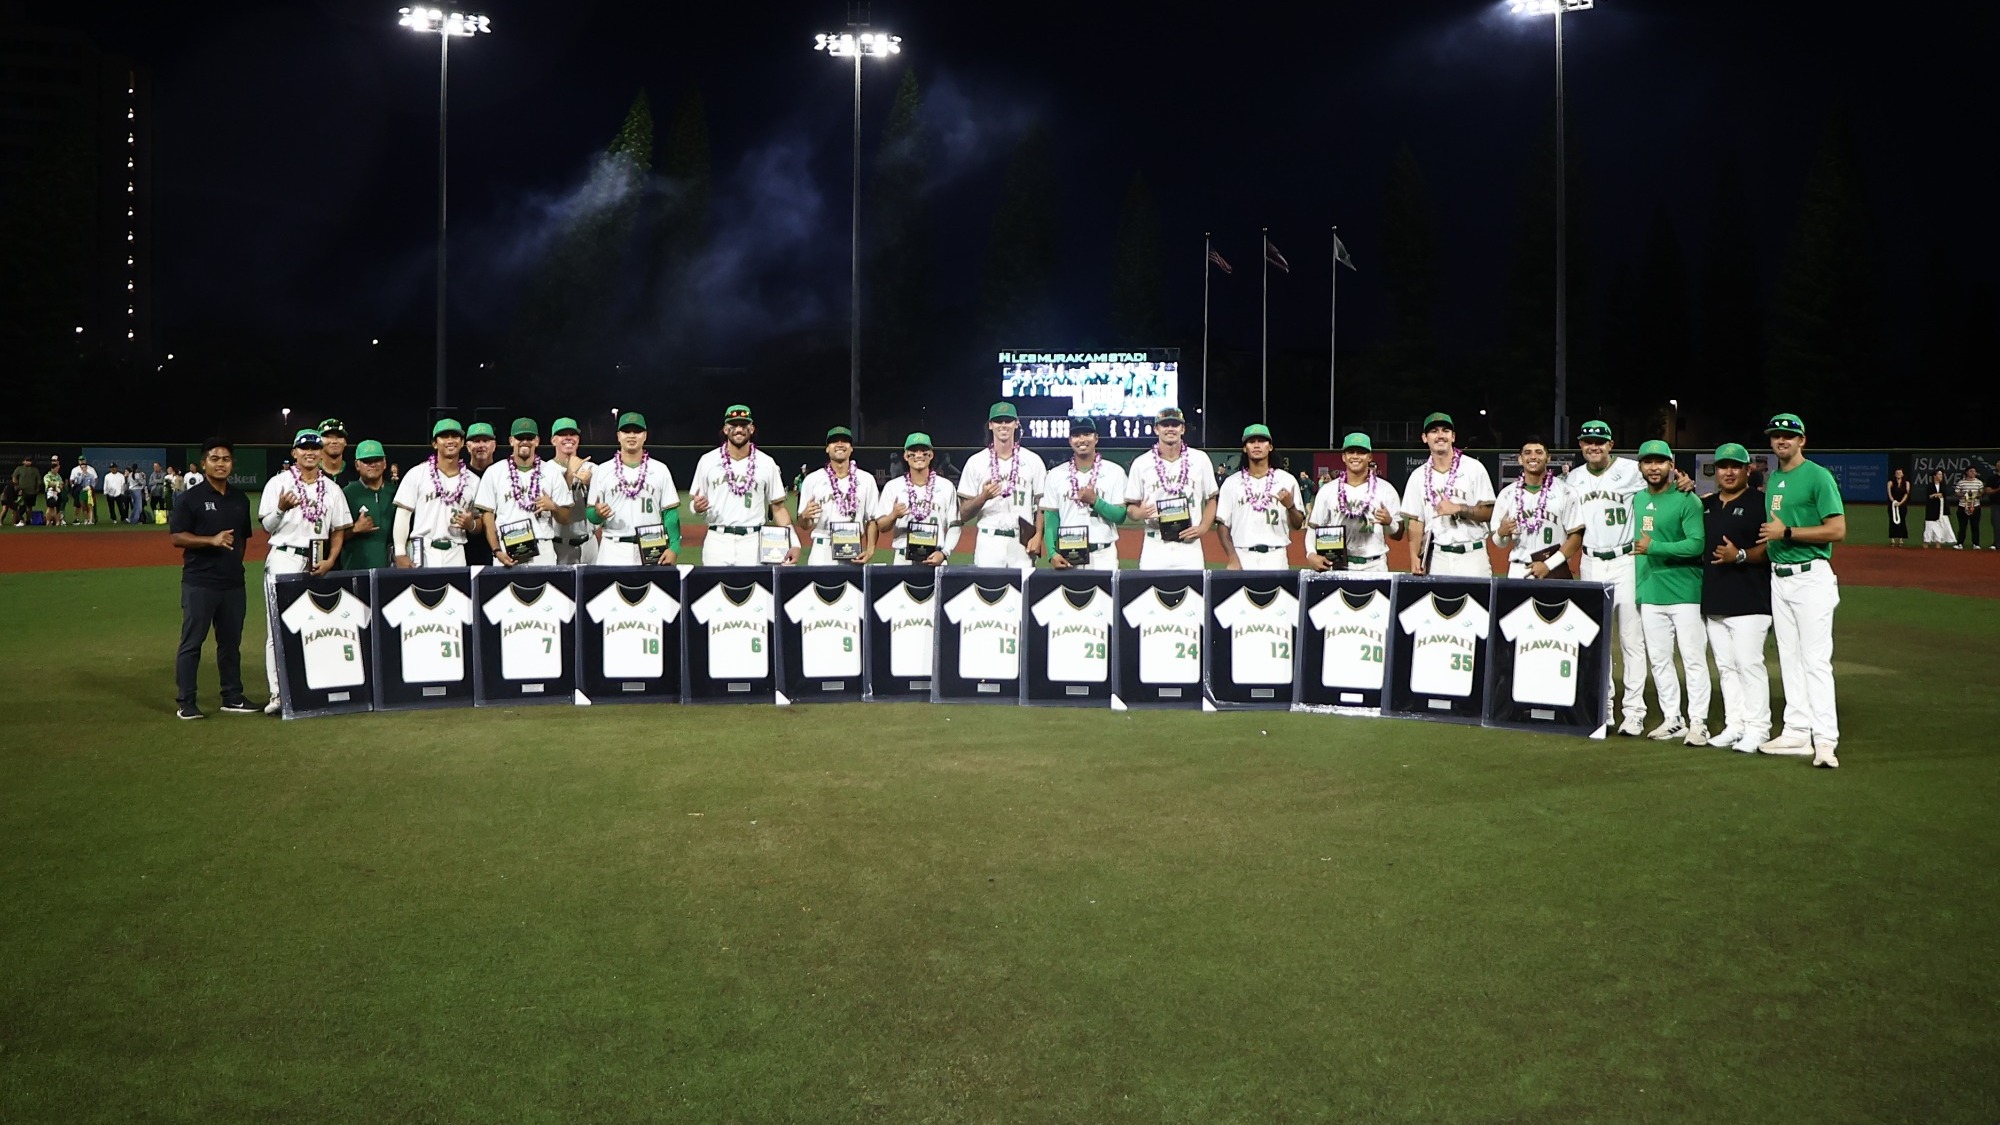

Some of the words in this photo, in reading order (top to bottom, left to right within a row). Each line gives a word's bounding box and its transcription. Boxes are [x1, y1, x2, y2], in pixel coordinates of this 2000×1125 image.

[1038, 353, 1107, 362] MURAKAMI
[1914, 457, 1971, 471] ISLAND
[227, 473, 257, 484] eken
[744, 492, 753, 508] 6
[1013, 490, 1026, 506] 13
[1265, 508, 1280, 525] 12
[1605, 507, 1627, 526] 30
[1543, 527, 1553, 545] 8
[343, 644, 355, 662] 5
[441, 641, 462, 658] 31
[542, 638, 553, 654] 7
[751, 637, 762, 653] 6
[843, 637, 854, 652] 9
[999, 638, 1017, 654] 13
[1084, 642, 1106, 659] 29
[1174, 642, 1199, 660] 24
[1269, 642, 1290, 660] 12
[1359, 644, 1384, 663] 20
[1449, 653, 1473, 672] 35
[1559, 660, 1572, 678] 8
